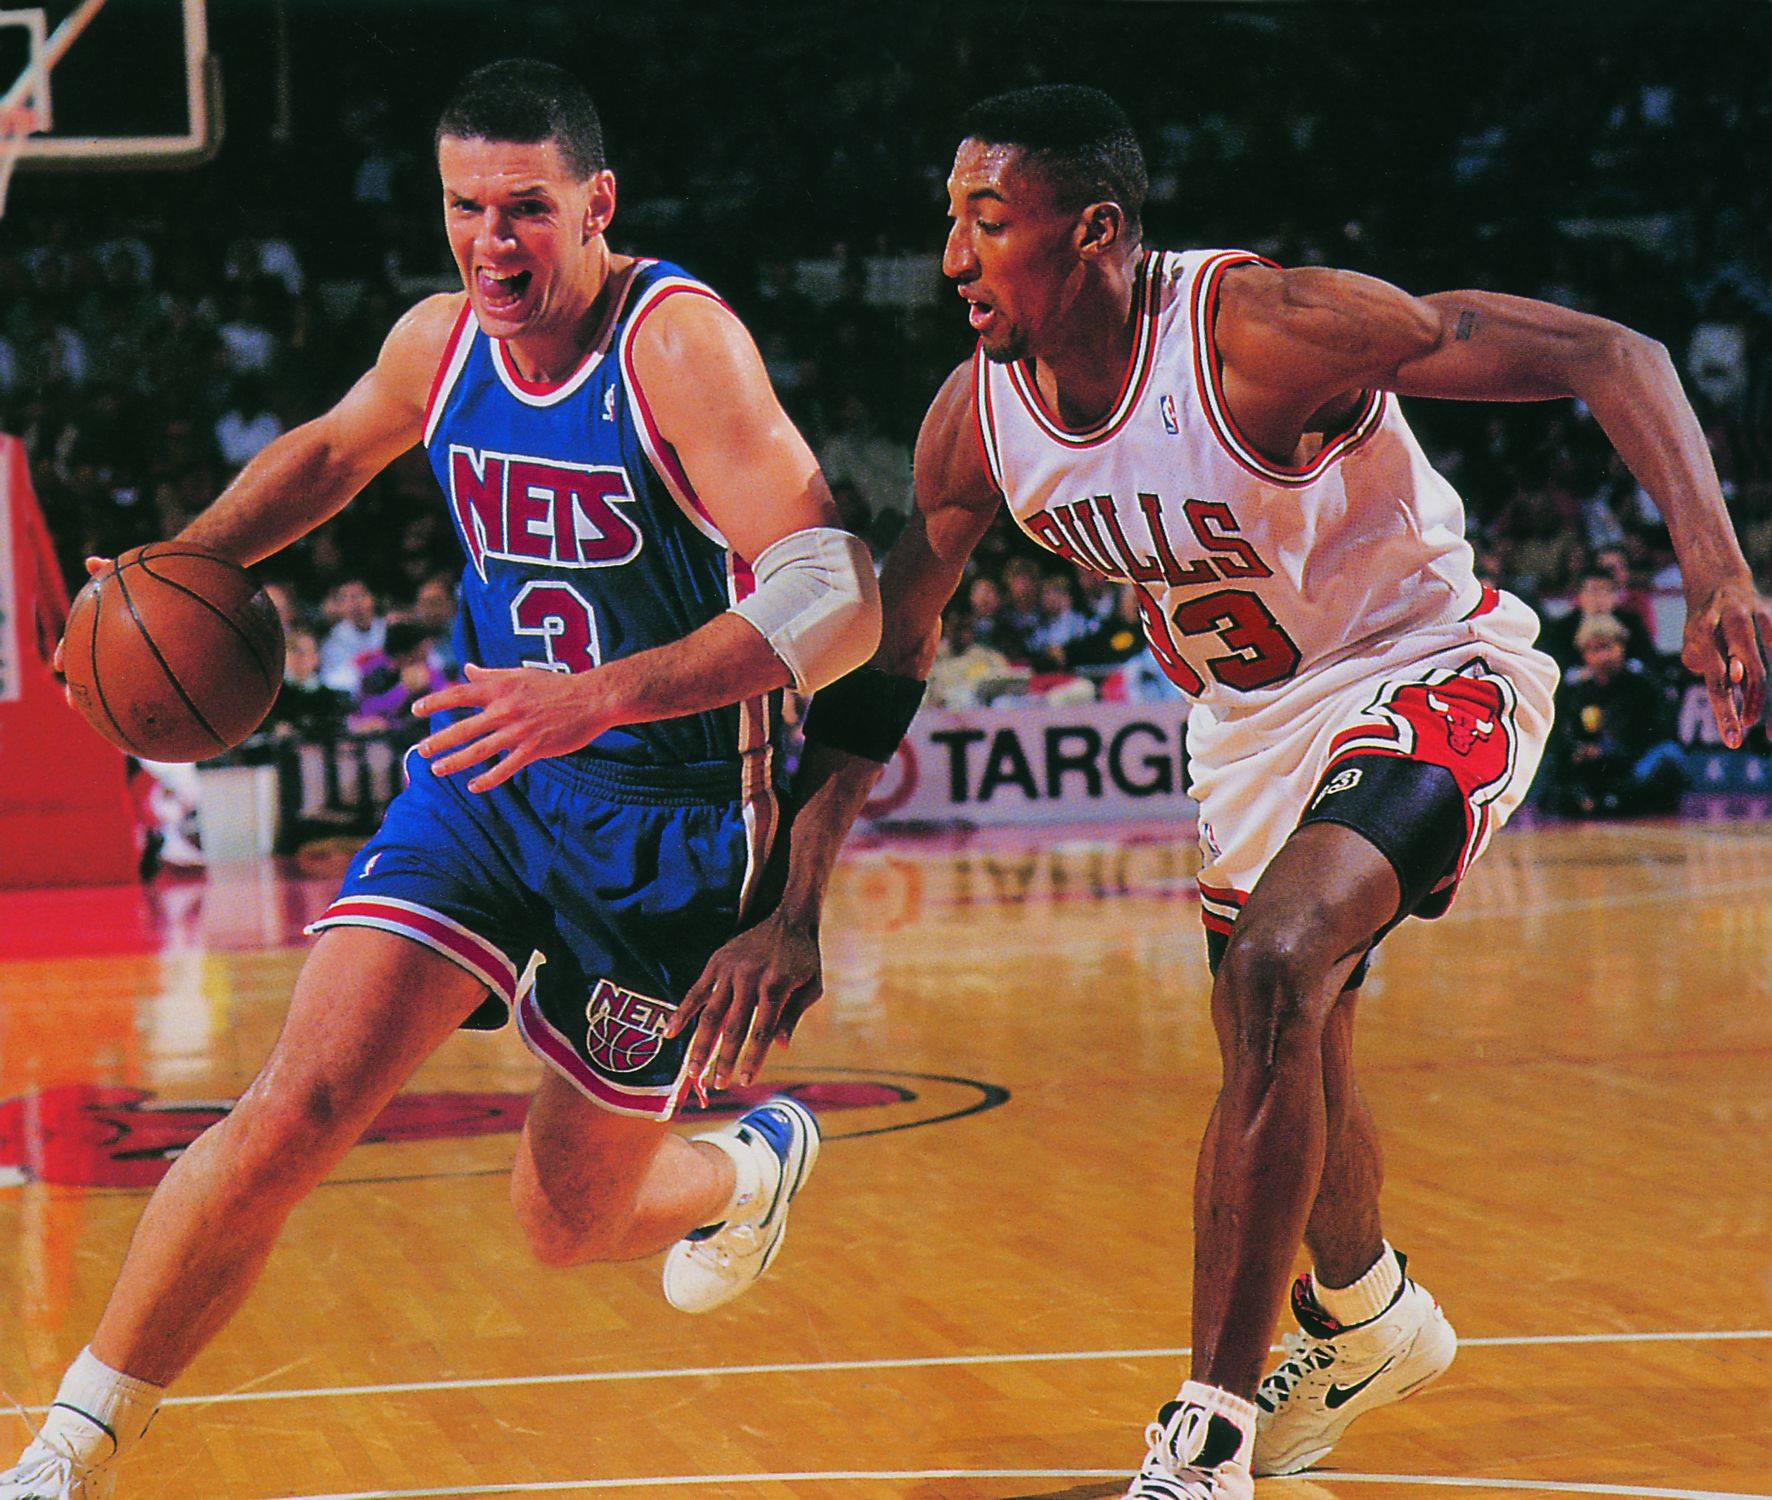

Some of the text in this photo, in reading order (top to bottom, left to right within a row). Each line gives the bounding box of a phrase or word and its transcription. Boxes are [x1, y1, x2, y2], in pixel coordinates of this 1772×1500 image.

[449, 443, 643, 584] NETS
[510, 580, 601, 675] 3
[929, 720, 1193, 804] TARG
[586, 978, 680, 1036] NET
